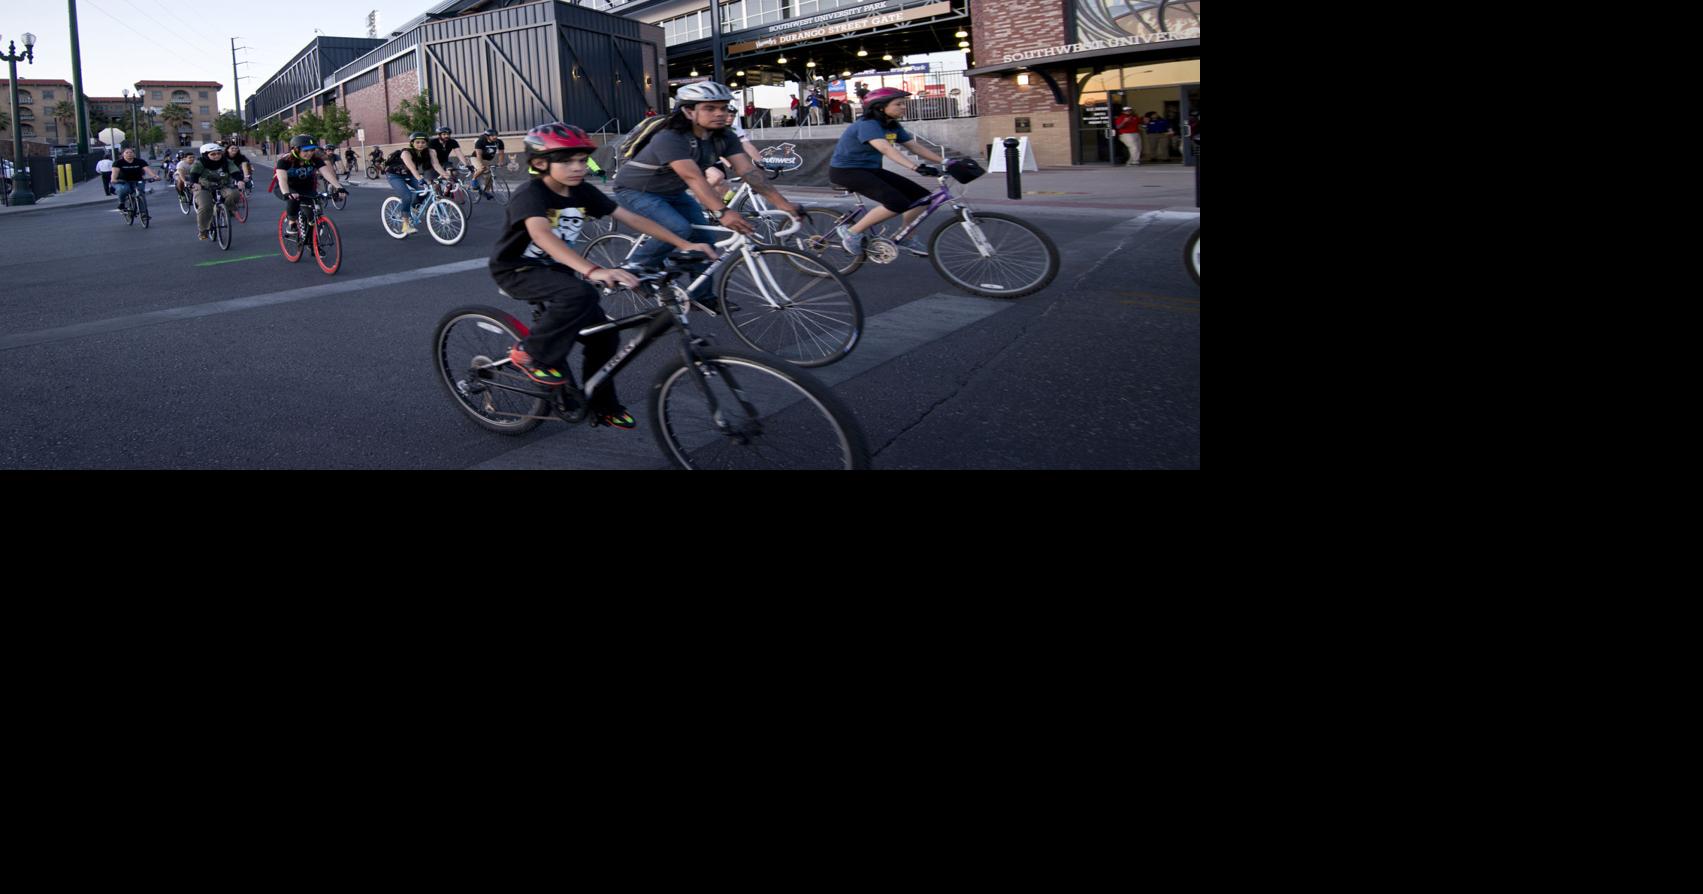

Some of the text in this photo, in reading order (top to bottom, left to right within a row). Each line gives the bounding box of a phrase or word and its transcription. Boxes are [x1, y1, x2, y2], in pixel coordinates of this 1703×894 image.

[769, 1, 887, 32] SOUTHWEST UNIVERSITY PARK
[780, 13, 903, 43] DURANGO STREET GATE
[1003, 40, 1103, 63] SOUTHWEST
